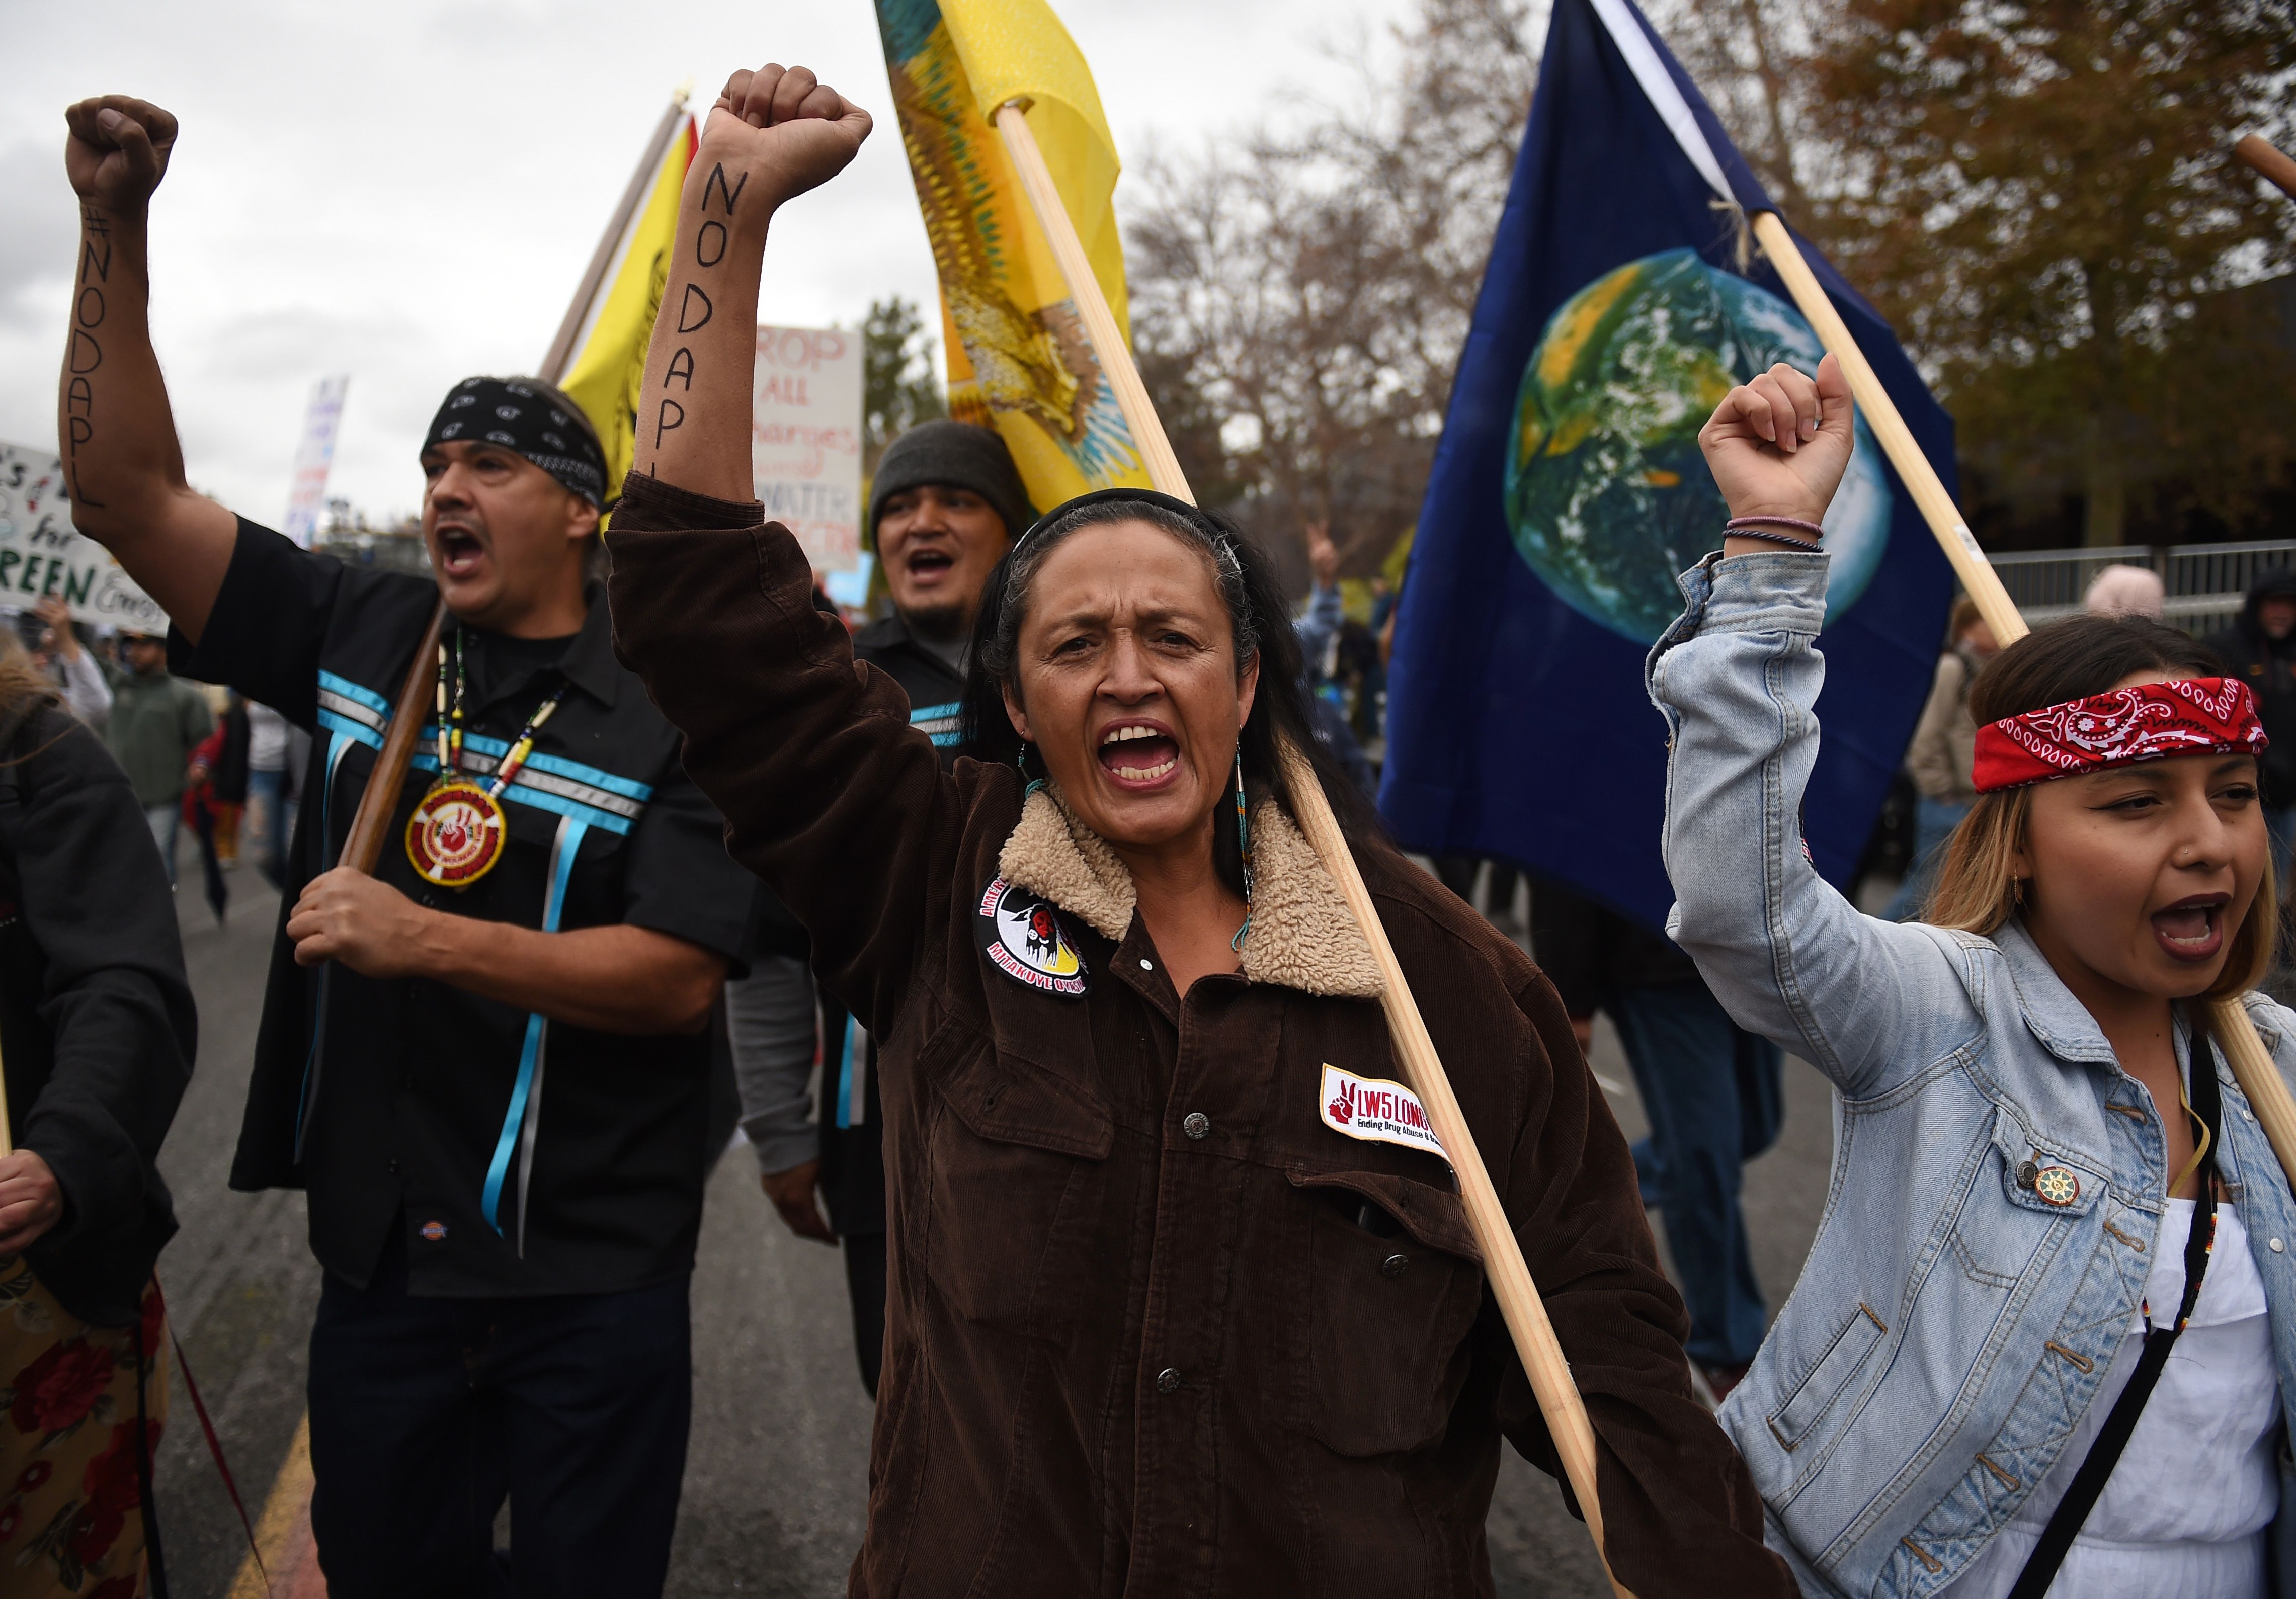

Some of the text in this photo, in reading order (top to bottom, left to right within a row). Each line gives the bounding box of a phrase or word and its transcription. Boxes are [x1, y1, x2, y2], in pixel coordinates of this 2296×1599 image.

[651, 161, 748, 478] NODAP
[757, 326, 846, 372] ROP
[0, 551, 95, 608] REEN
[987, 941, 1052, 990] MITAKUYE
[1358, 1118, 1383, 1131] Ending
[1385, 1121, 1401, 1135] Drug
[1403, 1126, 1423, 1138] Abuse
